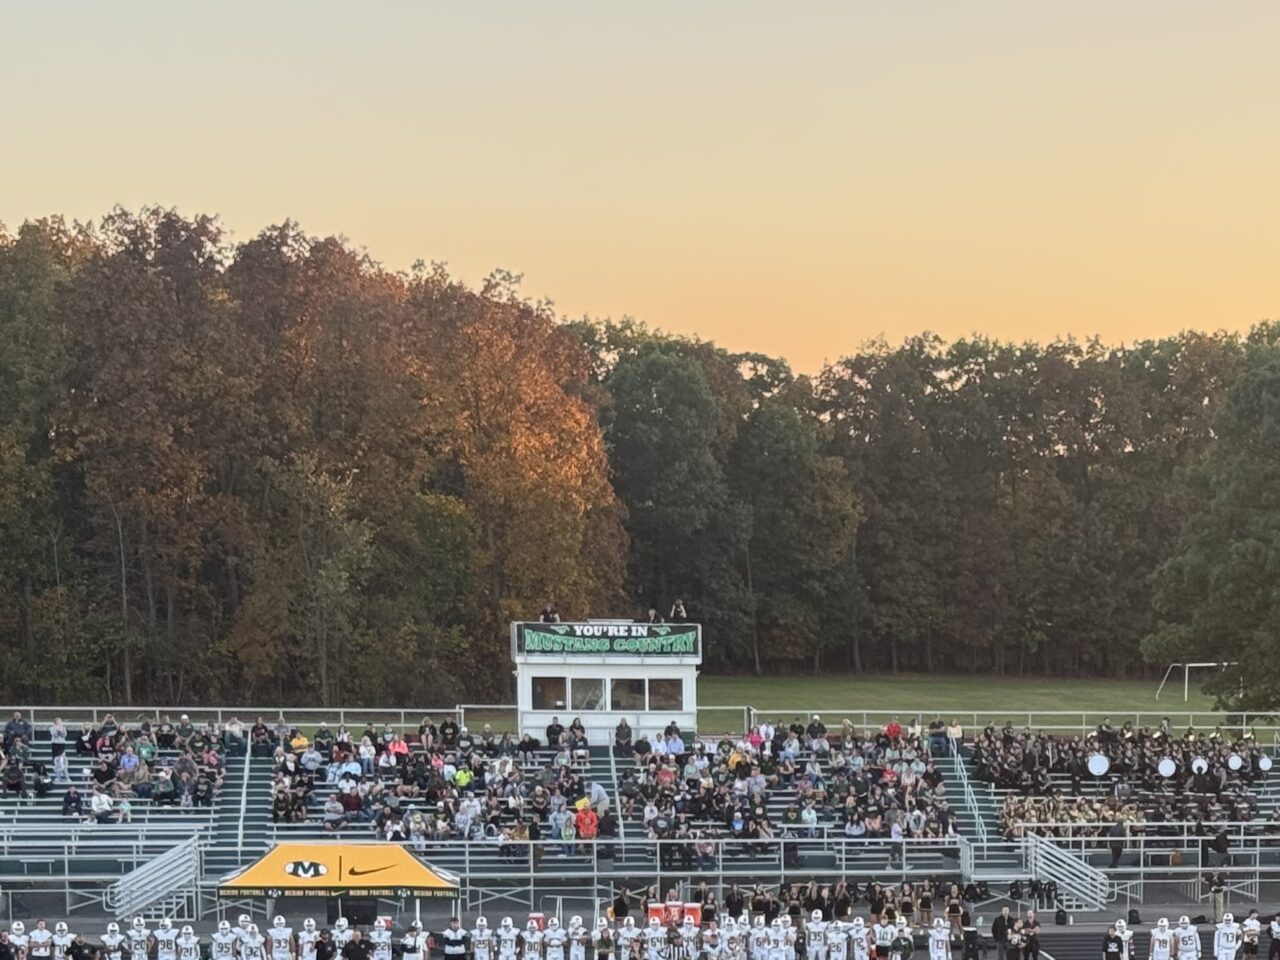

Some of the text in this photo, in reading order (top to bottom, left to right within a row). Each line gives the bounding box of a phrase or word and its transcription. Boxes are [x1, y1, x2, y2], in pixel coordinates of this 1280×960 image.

[574, 626, 648, 636] YOU'RE IN
[525, 629, 697, 653] MUSTANG COUNTRY
